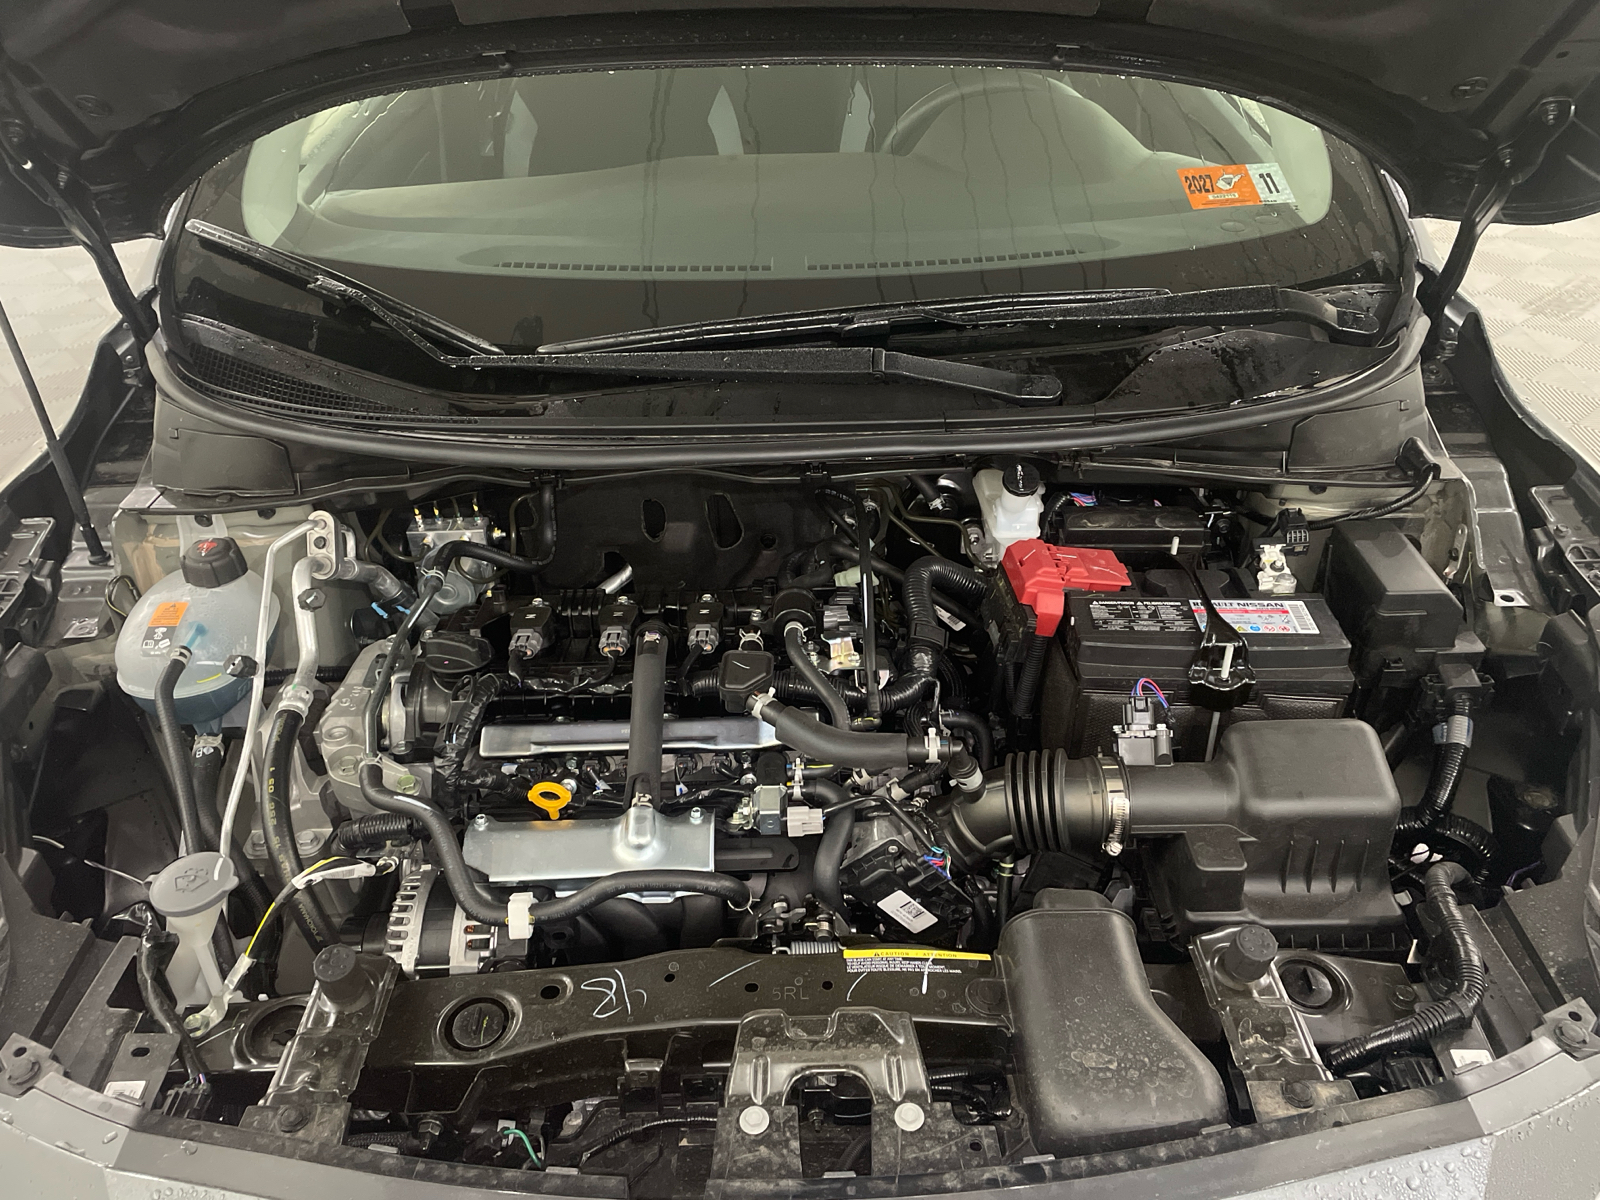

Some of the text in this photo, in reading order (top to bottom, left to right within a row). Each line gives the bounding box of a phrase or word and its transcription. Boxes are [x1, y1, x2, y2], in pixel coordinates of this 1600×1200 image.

[1184, 174, 1215, 194] 2027
[1258, 172, 1280, 194] 11
[298, 903, 319, 938] YOKOHAMA
